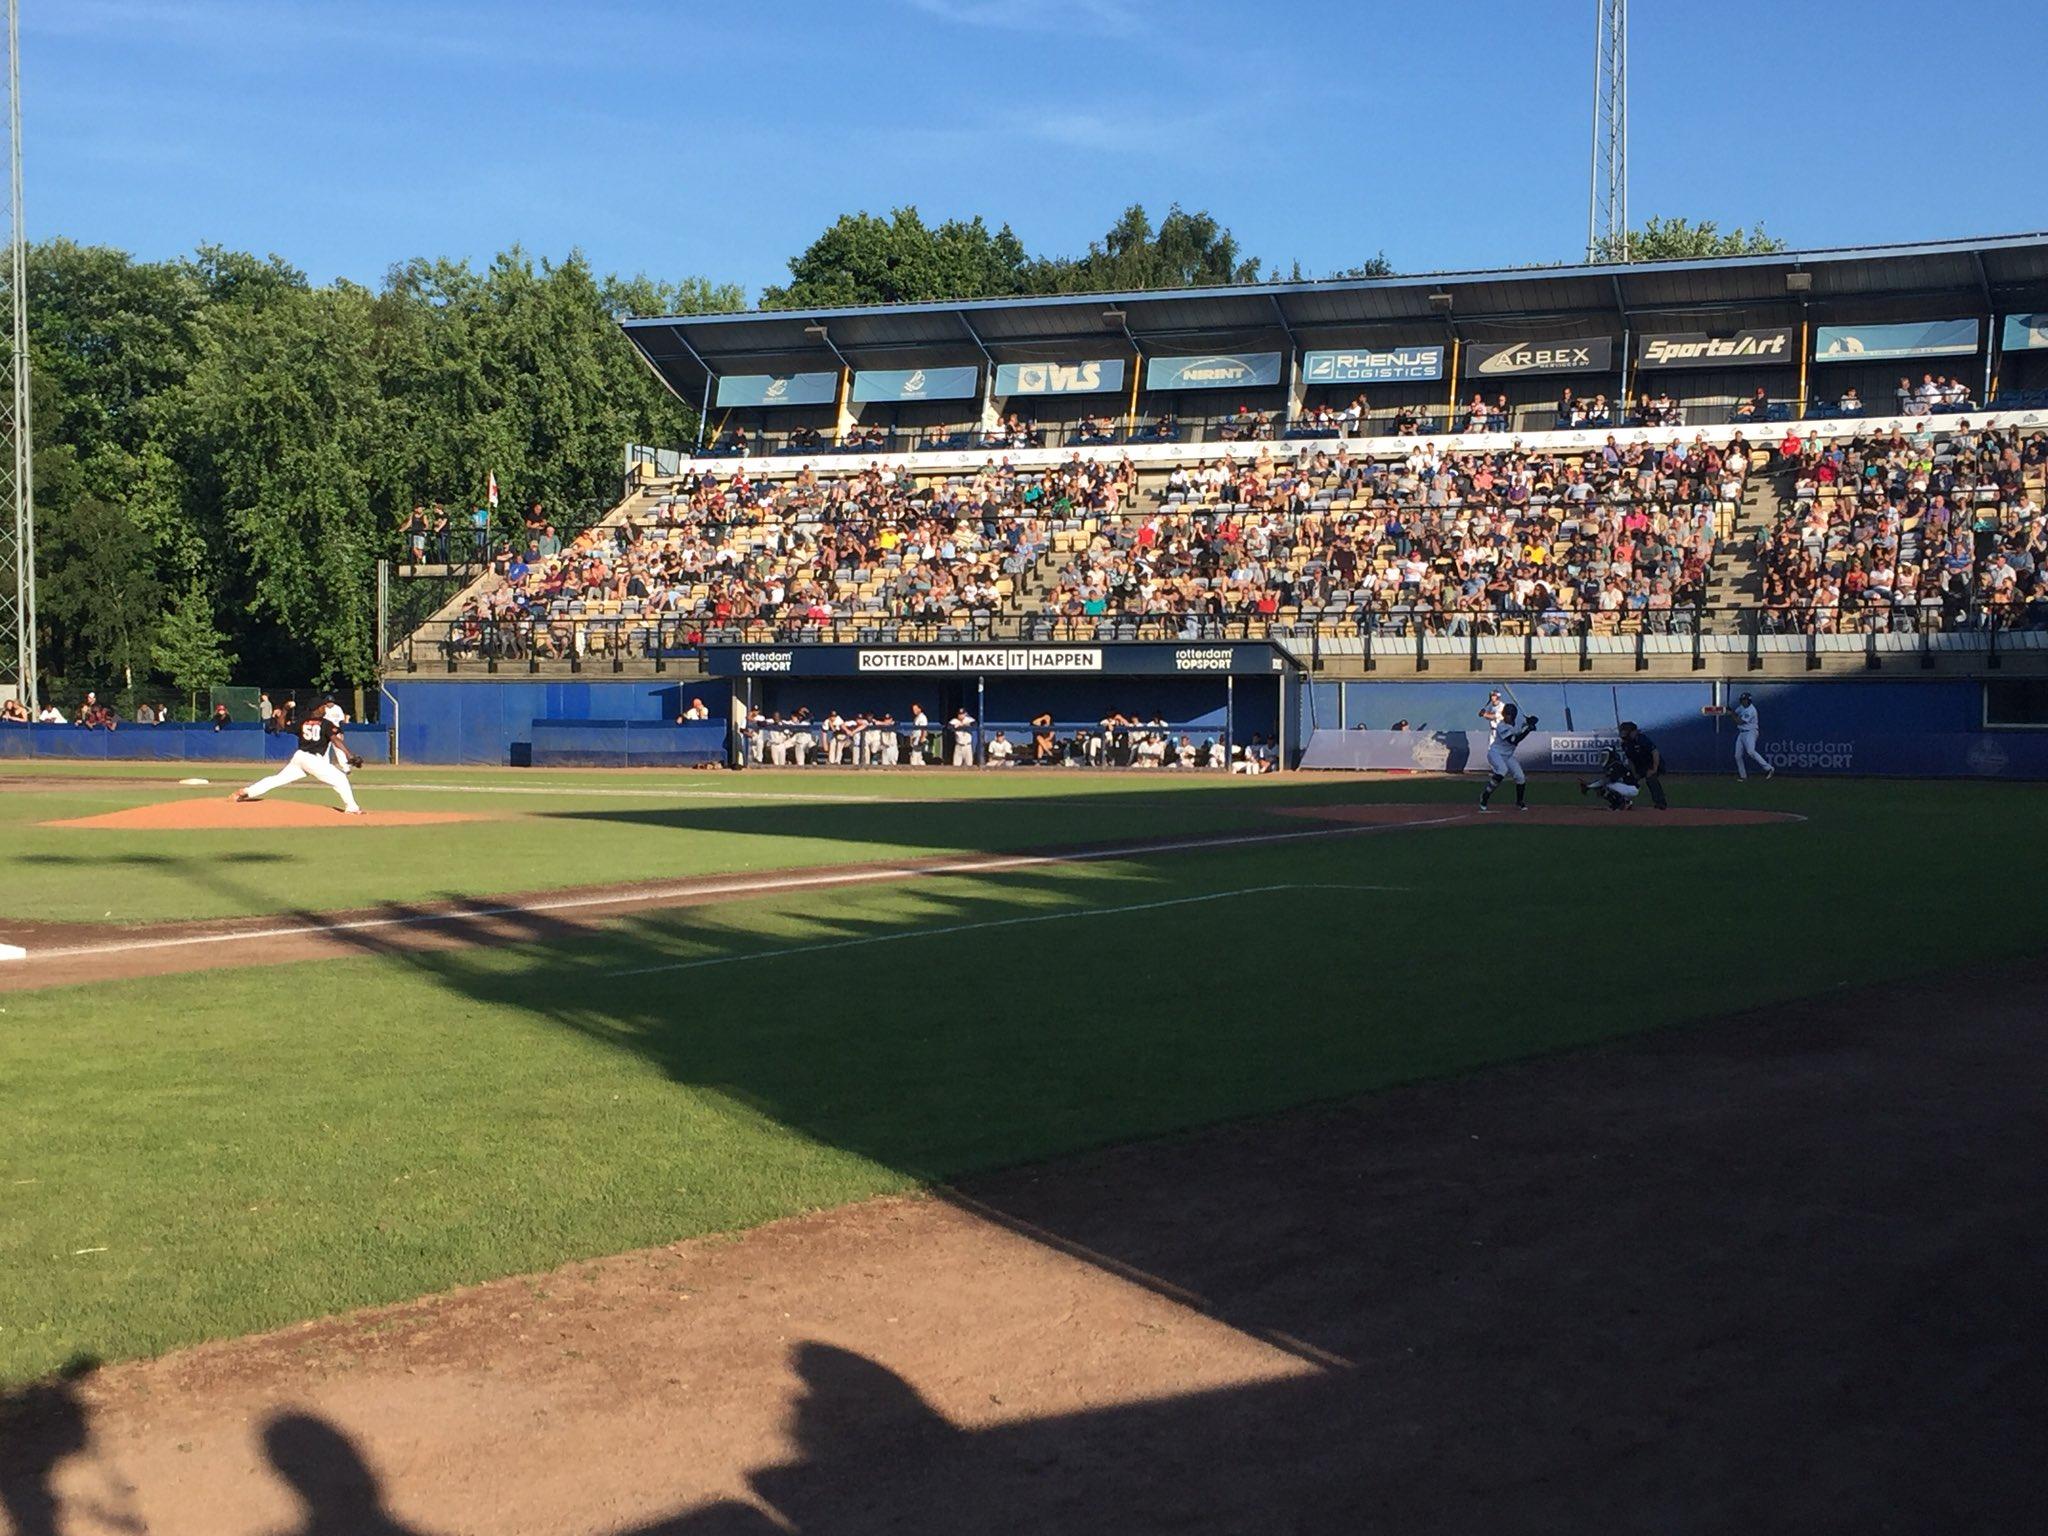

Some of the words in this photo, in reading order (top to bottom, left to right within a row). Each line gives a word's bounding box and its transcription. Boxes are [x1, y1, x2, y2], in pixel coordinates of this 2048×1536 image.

[1336, 352, 1438, 368] RHENUS
[1497, 347, 1589, 366] ARBEX
[1049, 363, 1100, 391] VLS
[1335, 366, 1436, 379] LOGISTICS
[742, 652, 791, 662] rotterdam
[862, 654, 954, 667] ROTTERDAM.
[962, 654, 1004, 667] MAKE
[1012, 654, 1024, 667] IT
[1032, 653, 1093, 667] HAPPEN
[1176, 649, 1231, 659] rotterdam
[742, 661, 791, 672] TOPSPORT
[1176, 658, 1231, 670] TOPSPORT
[302, 724, 321, 741] 50
[1765, 740, 1852, 753] rotterdam
[1554, 753, 1586, 763] MAKE
[1591, 753, 1600, 763] IT
[1766, 754, 1852, 768] TOPSPORT
